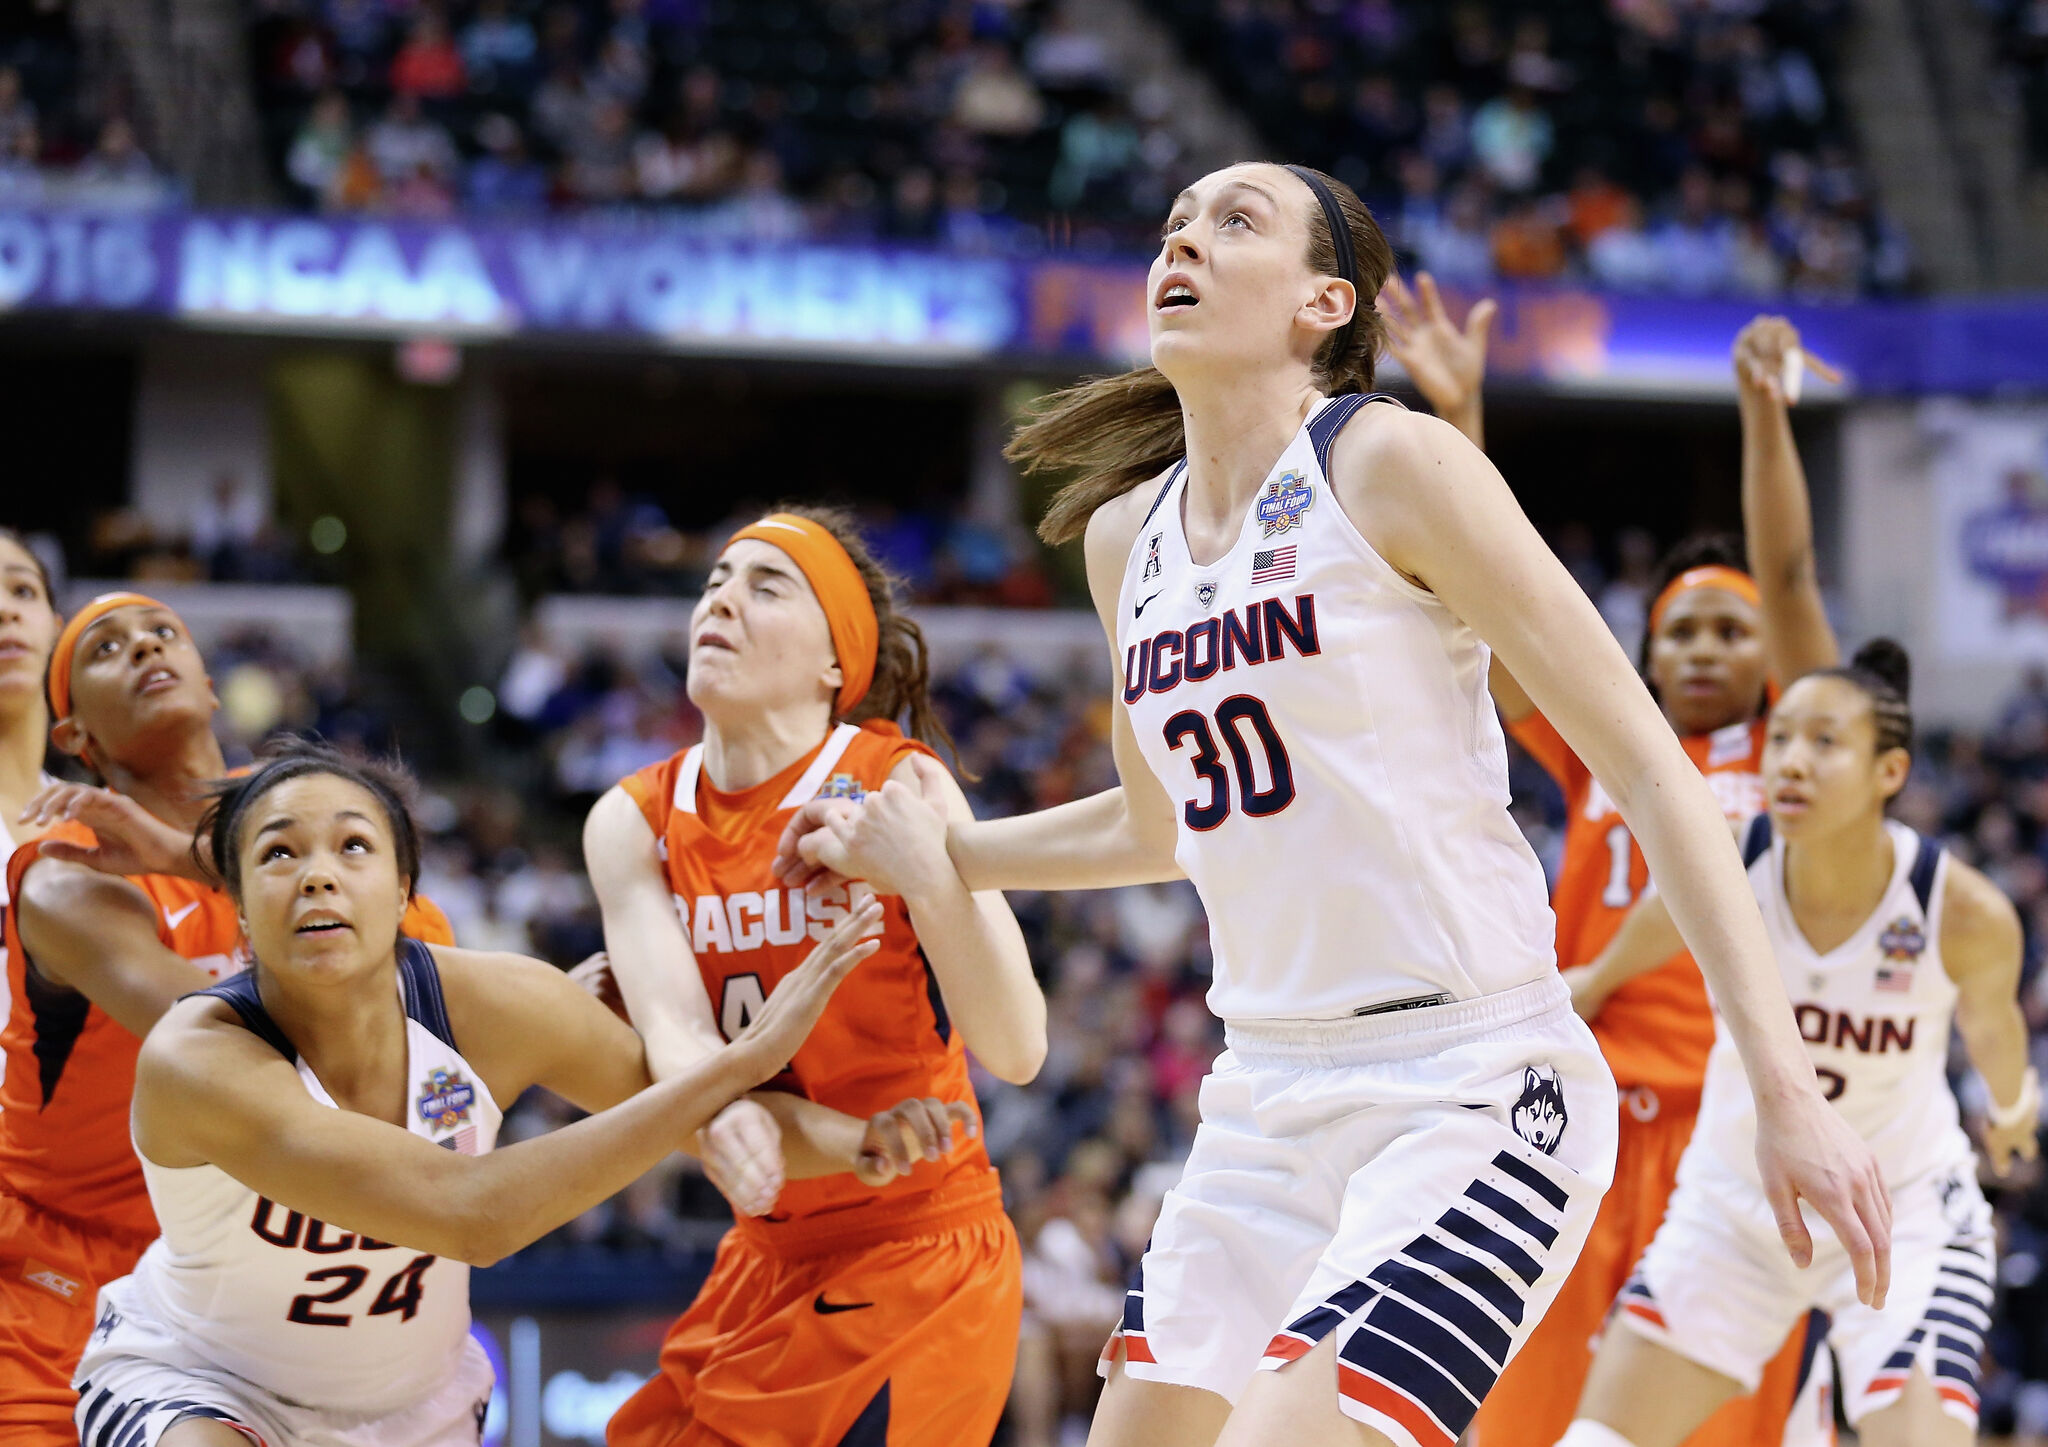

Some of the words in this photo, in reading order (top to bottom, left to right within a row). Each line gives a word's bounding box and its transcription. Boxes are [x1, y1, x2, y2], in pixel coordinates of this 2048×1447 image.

[0, 214, 158, 306] 016
[178, 217, 502, 324] NCAA
[512, 228, 1014, 345] WOMEN'S
[1261, 500, 1283, 515] FINAL
[1285, 493, 1307, 508] FOUR
[1124, 593, 1322, 705] UCONN
[1162, 693, 1297, 832] 30
[674, 880, 885, 954] ACUSE
[1795, 1002, 1917, 1054] ONN
[26, 1270, 80, 1299] ACC
[286, 1254, 437, 1328] 24
